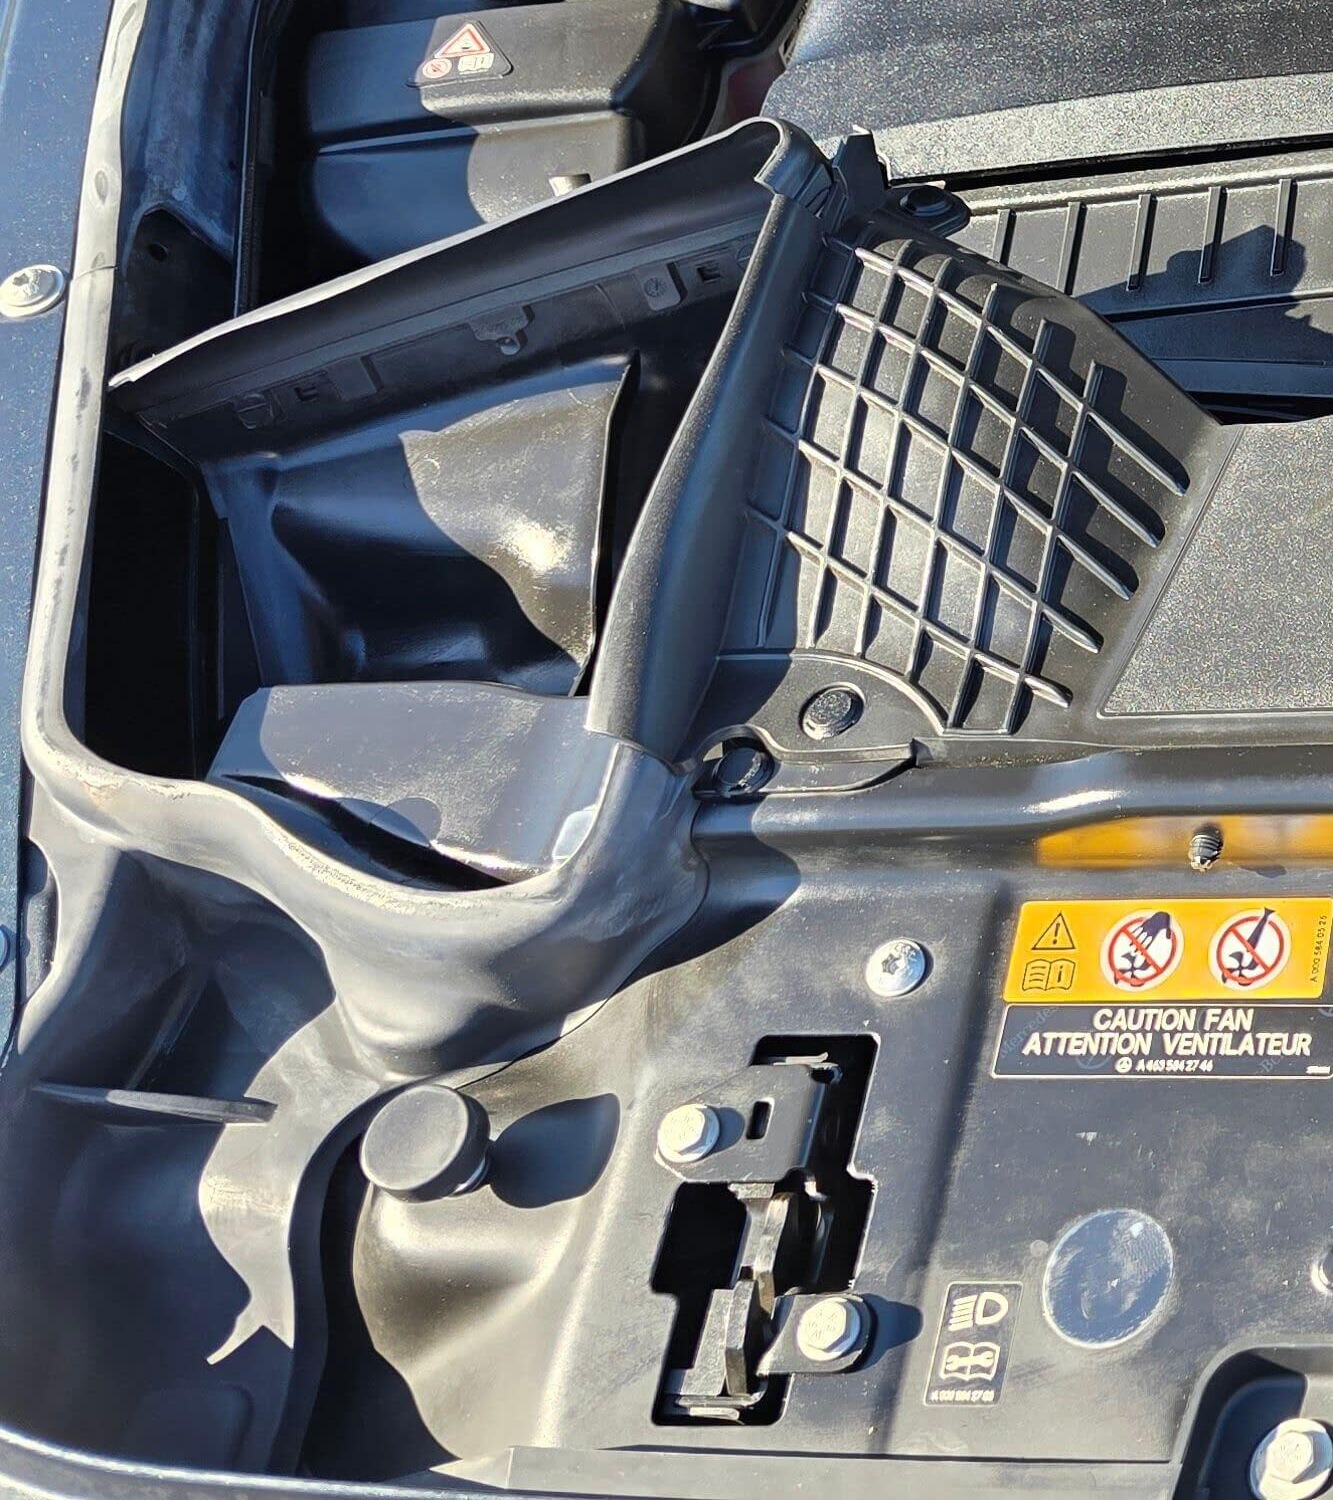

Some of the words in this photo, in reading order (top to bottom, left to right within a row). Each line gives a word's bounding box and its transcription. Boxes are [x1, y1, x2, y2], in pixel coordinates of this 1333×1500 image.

[1093, 1008, 1196, 1031] CAUTION
[1202, 1008, 1254, 1031] FAN
[1022, 1032, 1154, 1056] ATTENTION
[1164, 1033, 1312, 1057] VENTILATEUR
[1135, 1059, 1146, 1072] A
[1185, 1059, 1199, 1072] 27
